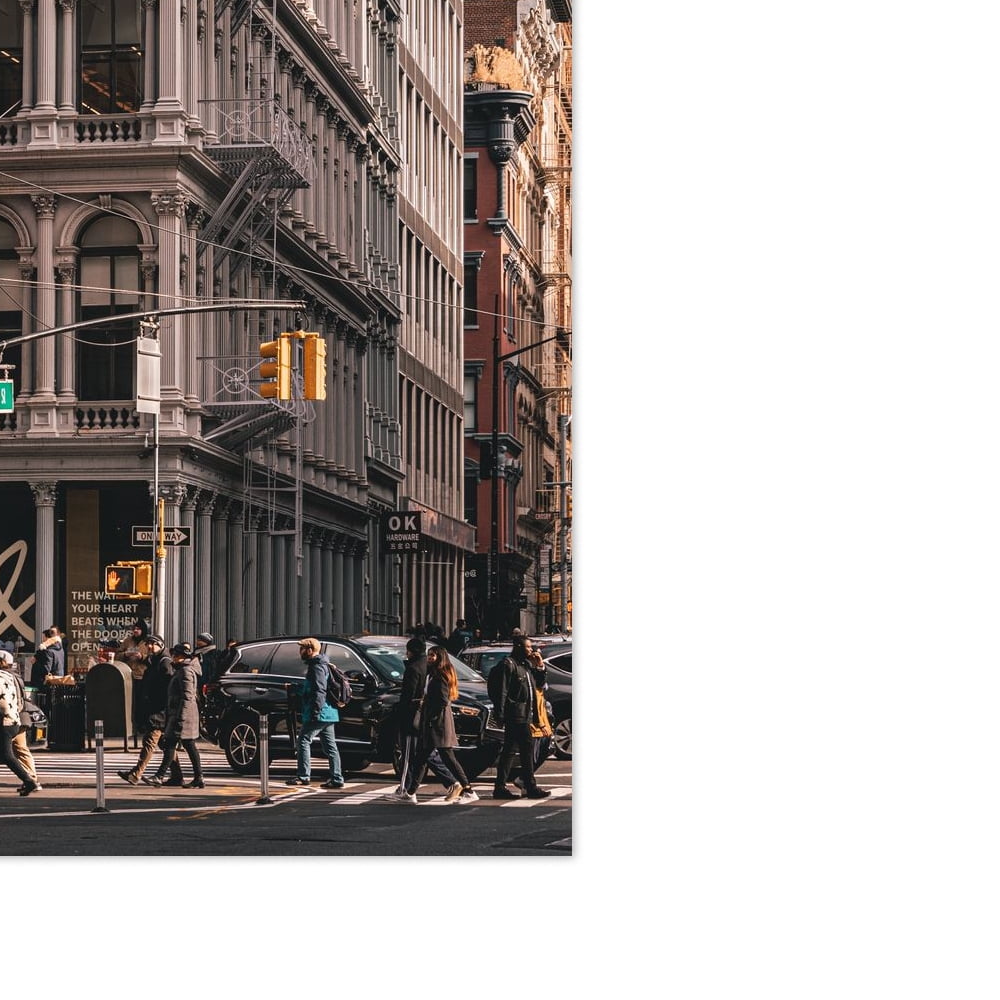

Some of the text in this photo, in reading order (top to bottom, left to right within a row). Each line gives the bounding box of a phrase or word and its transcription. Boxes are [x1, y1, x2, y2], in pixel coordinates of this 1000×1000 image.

[388, 516, 417, 531] OK
[164, 532, 182, 541] WAY
[386, 533, 420, 542] HARDWARE
[72, 591, 92, 600] THE
[72, 604, 138, 613] YOUR HEART
[72, 617, 139, 626] BEATS WHEN
[72, 630, 92, 639] THE
